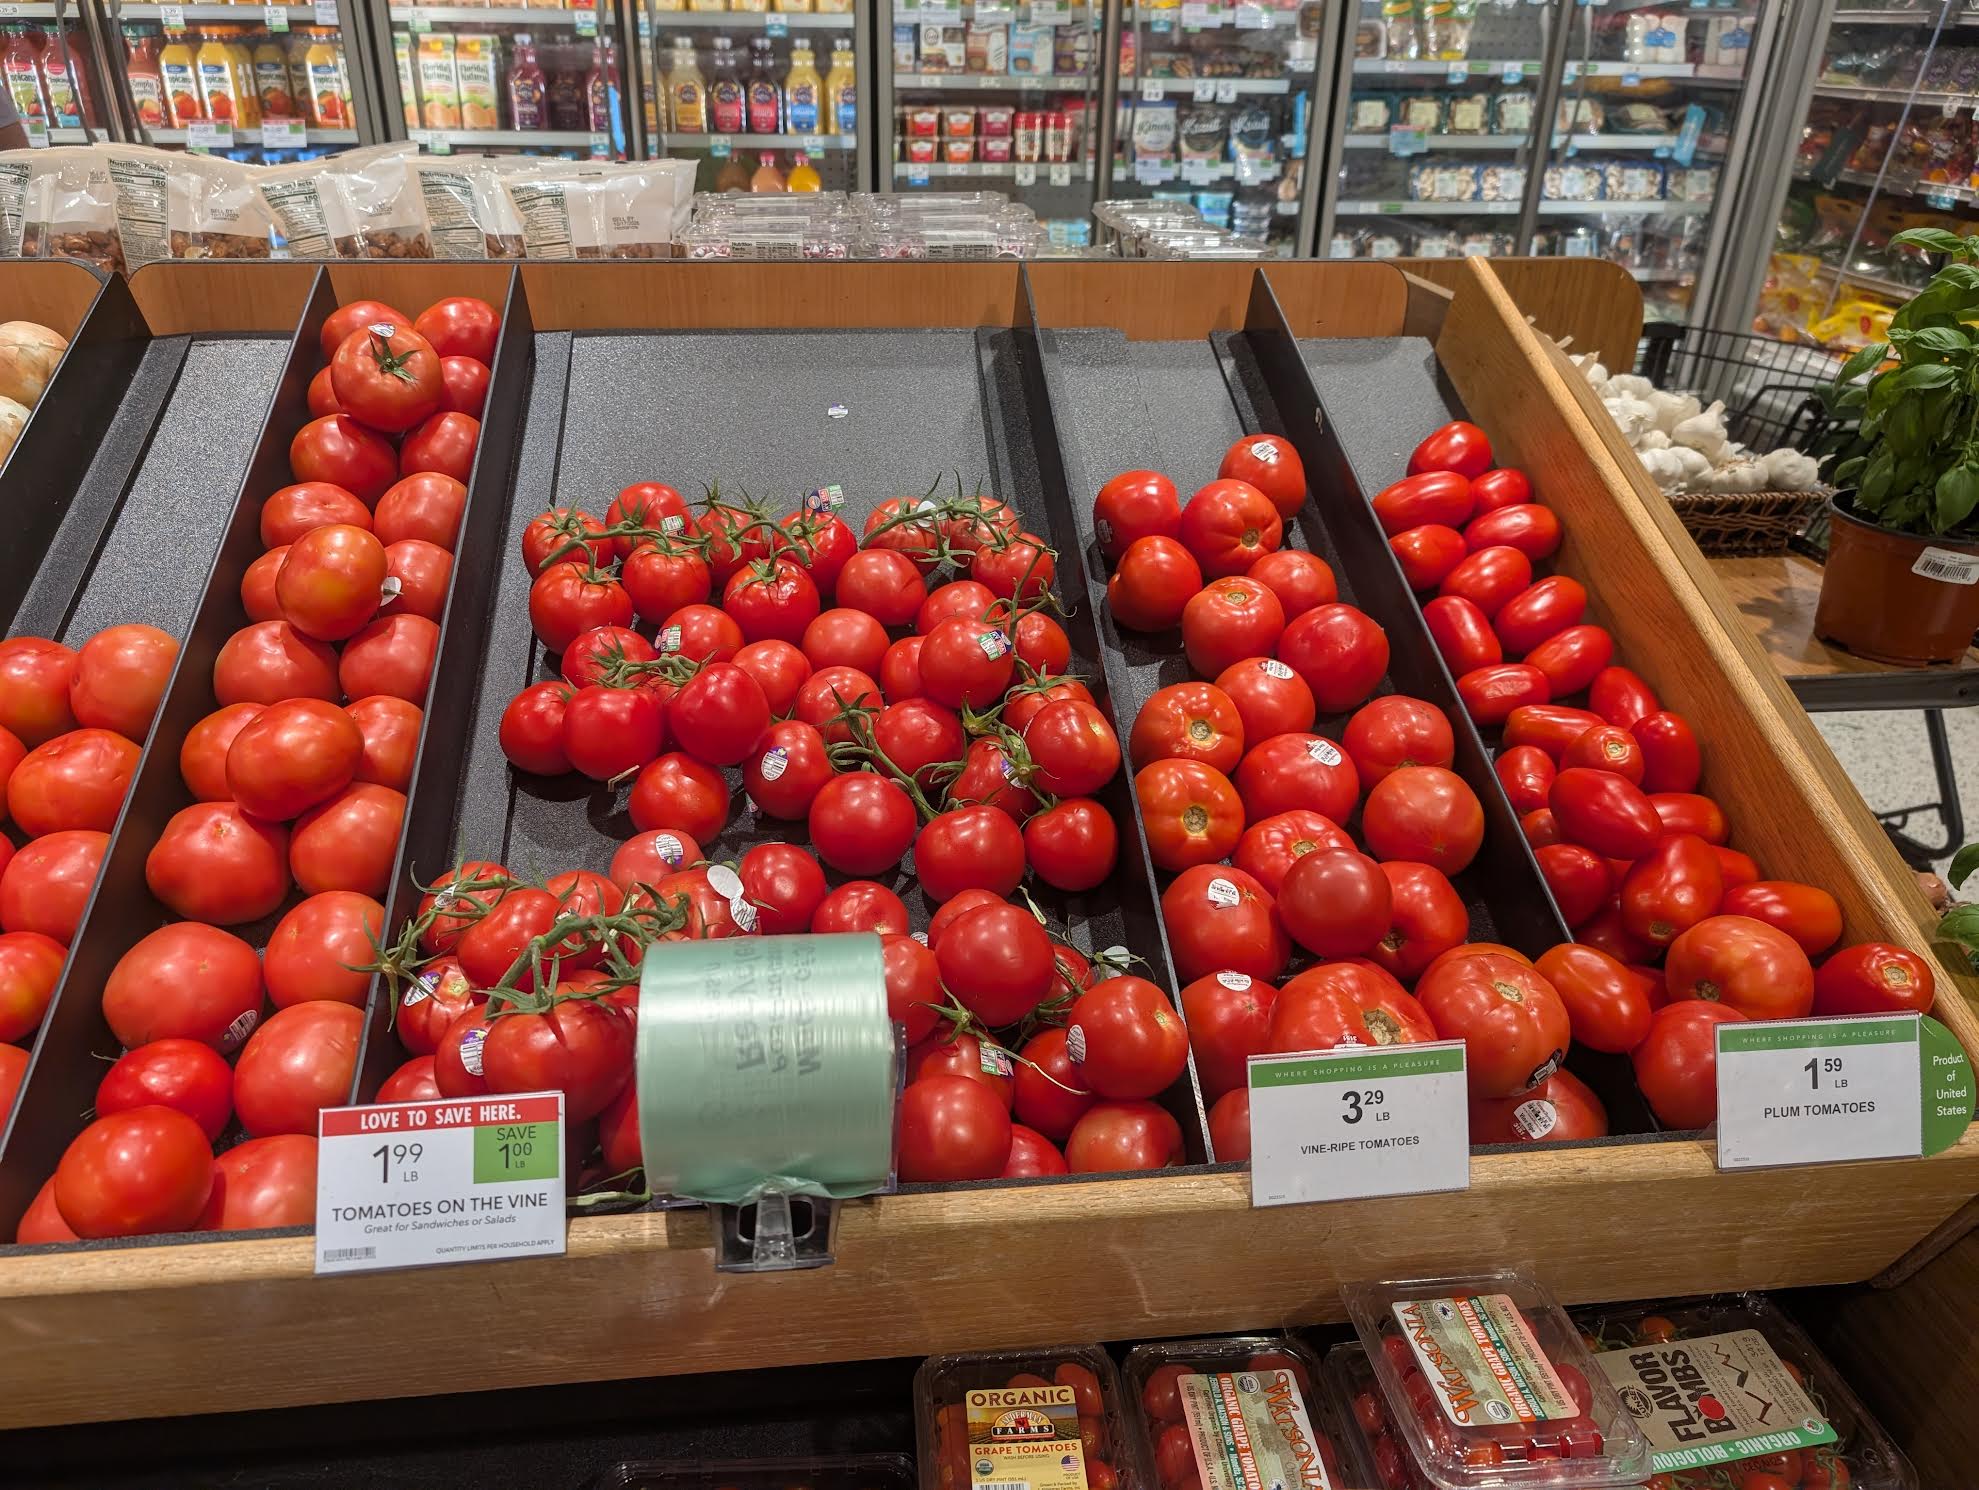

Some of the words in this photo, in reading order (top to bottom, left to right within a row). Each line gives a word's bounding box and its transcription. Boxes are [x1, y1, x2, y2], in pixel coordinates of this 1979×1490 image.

[1742, 1036, 1772, 1044] WHERE
[1778, 1033, 1823, 1041] SHOPPING
[1852, 1029, 1896, 1037] PLEASURE
[1275, 1070, 1308, 1078] WHERE
[1314, 1065, 1363, 1075] SHOPPING
[1393, 1059, 1440, 1068] PLEASURE
[1933, 1054, 1964, 1066] Product
[1835, 1079, 1848, 1088] LB
[1947, 1071, 1955, 1082] of
[1936, 1087, 1967, 1099] United
[360, 1112, 399, 1130] LOVE
[407, 1110, 427, 1127] TO
[435, 1106, 472, 1124] SAVE
[480, 1104, 522, 1122] HERE.
[1376, 1112, 1390, 1121] LB
[1764, 1105, 1800, 1119] PLUM
[1804, 1101, 1876, 1116] TOMATOES
[1937, 1105, 1967, 1116] States
[496, 1125, 537, 1141] SAVE
[1301, 1141, 1355, 1155] VINE-RIPE
[1359, 1136, 1420, 1150] TOMATOES
[515, 1160, 525, 1168] LB
[404, 1171, 418, 1182] LB
[332, 1201, 432, 1222] TOMATOES
[437, 1200, 465, 1215] ON
[470, 1196, 503, 1211] THE
[508, 1193, 548, 1208] VINE
[364, 1224, 392, 1235] Great
[395, 1222, 409, 1232] for
[411, 1219, 470, 1231] Sandwiches
[472, 1218, 483, 1226] or
[485, 1214, 516, 1225] Salads
[436, 1246, 466, 1254] QUANTITY
[499, 1240, 536, 1248] HOUSEHOLD
[1455, 1301, 1489, 1344] TOMATOES
[1402, 1303, 1480, 1424] WATSONIA
[1480, 1345, 1506, 1375] GRAPE
[1510, 1366, 1526, 1387] WATSON
[971, 1389, 1070, 1406] ORGANIC
[1202, 1389, 1213, 1410] Certified
[1499, 1377, 1531, 1417] ORGANIC
[1626, 1384, 1652, 1418] SUNSET
[1629, 1352, 1706, 1442] FLAVOR
[1207, 1411, 1218, 1429] Organic
[1220, 1377, 1237, 1415] ORGANIC
[1230, 1417, 1250, 1448] GRAPE
[996, 1426, 1050, 1434] FARMS
[1216, 1404, 1229, 1426] WATSON
[1223, 1431, 1234, 1445] SONS
[975, 1446, 1012, 1455] GRAPE
[1016, 1443, 1078, 1454] TOMATOES
[1197, 1430, 1208, 1451] PRODUCT
[1215, 1438, 1226, 1460] Clemson
[1734, 1432, 1801, 1454] ORGANIC
[1653, 1445, 1729, 1469] BIOLOGIQU
[1220, 1461, 1233, 1487] University
